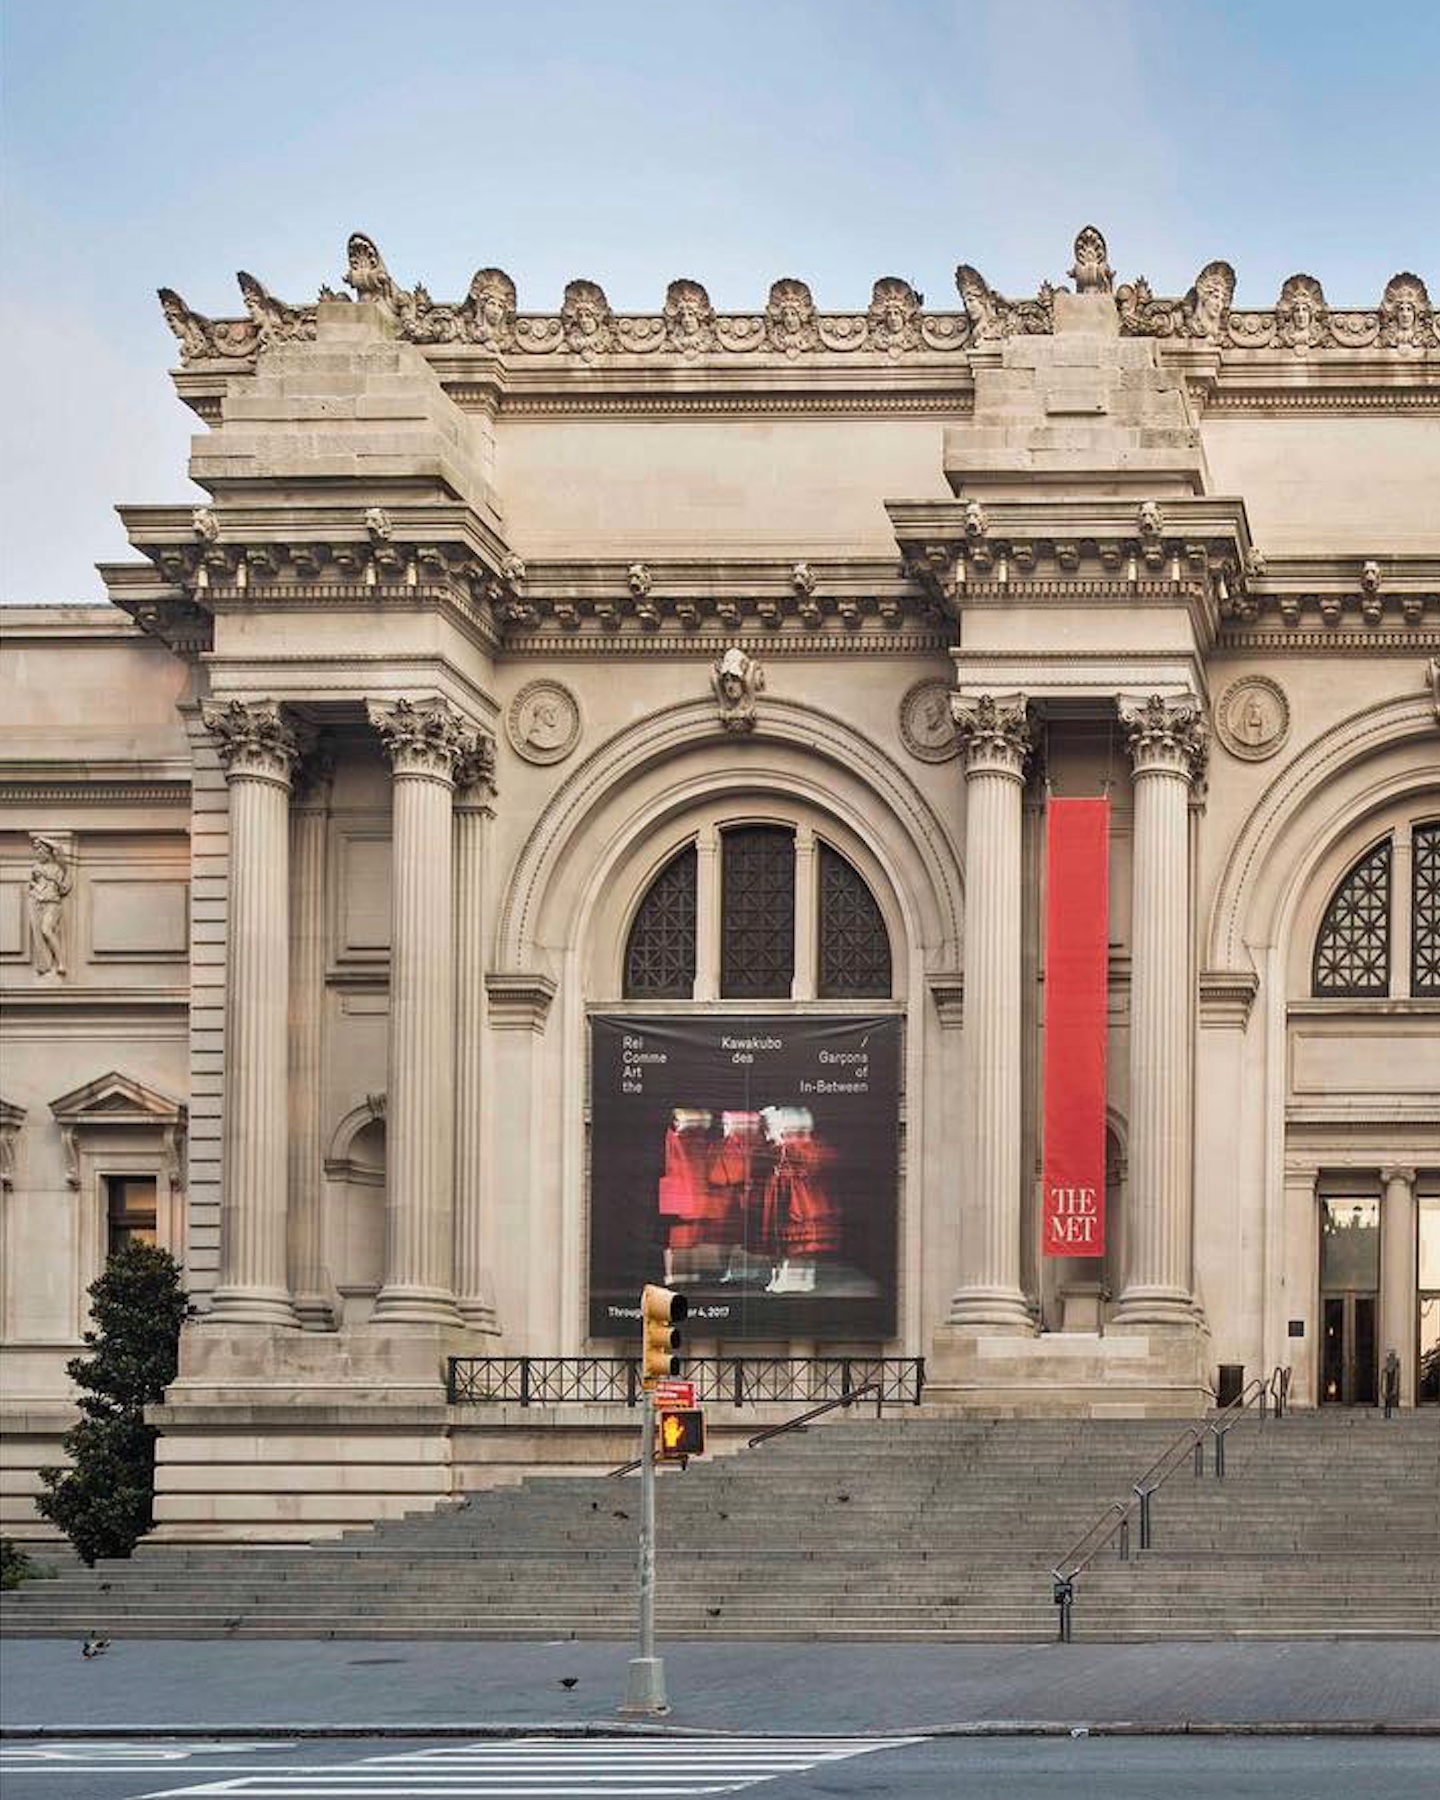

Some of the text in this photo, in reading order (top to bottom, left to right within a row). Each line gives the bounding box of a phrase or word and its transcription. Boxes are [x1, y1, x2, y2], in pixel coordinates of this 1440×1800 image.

[622, 1035, 643, 1049] Rei
[721, 1035, 782, 1049] Kawakubo
[622, 1049, 869, 1067] Comme des Garçons
[622, 1065, 869, 1078] Art of
[622, 1080, 869, 1094] the In-Between
[1051, 1188, 1096, 1214] THE
[1051, 1216, 1097, 1242] MET
[607, 1305, 643, 1320] Throug
